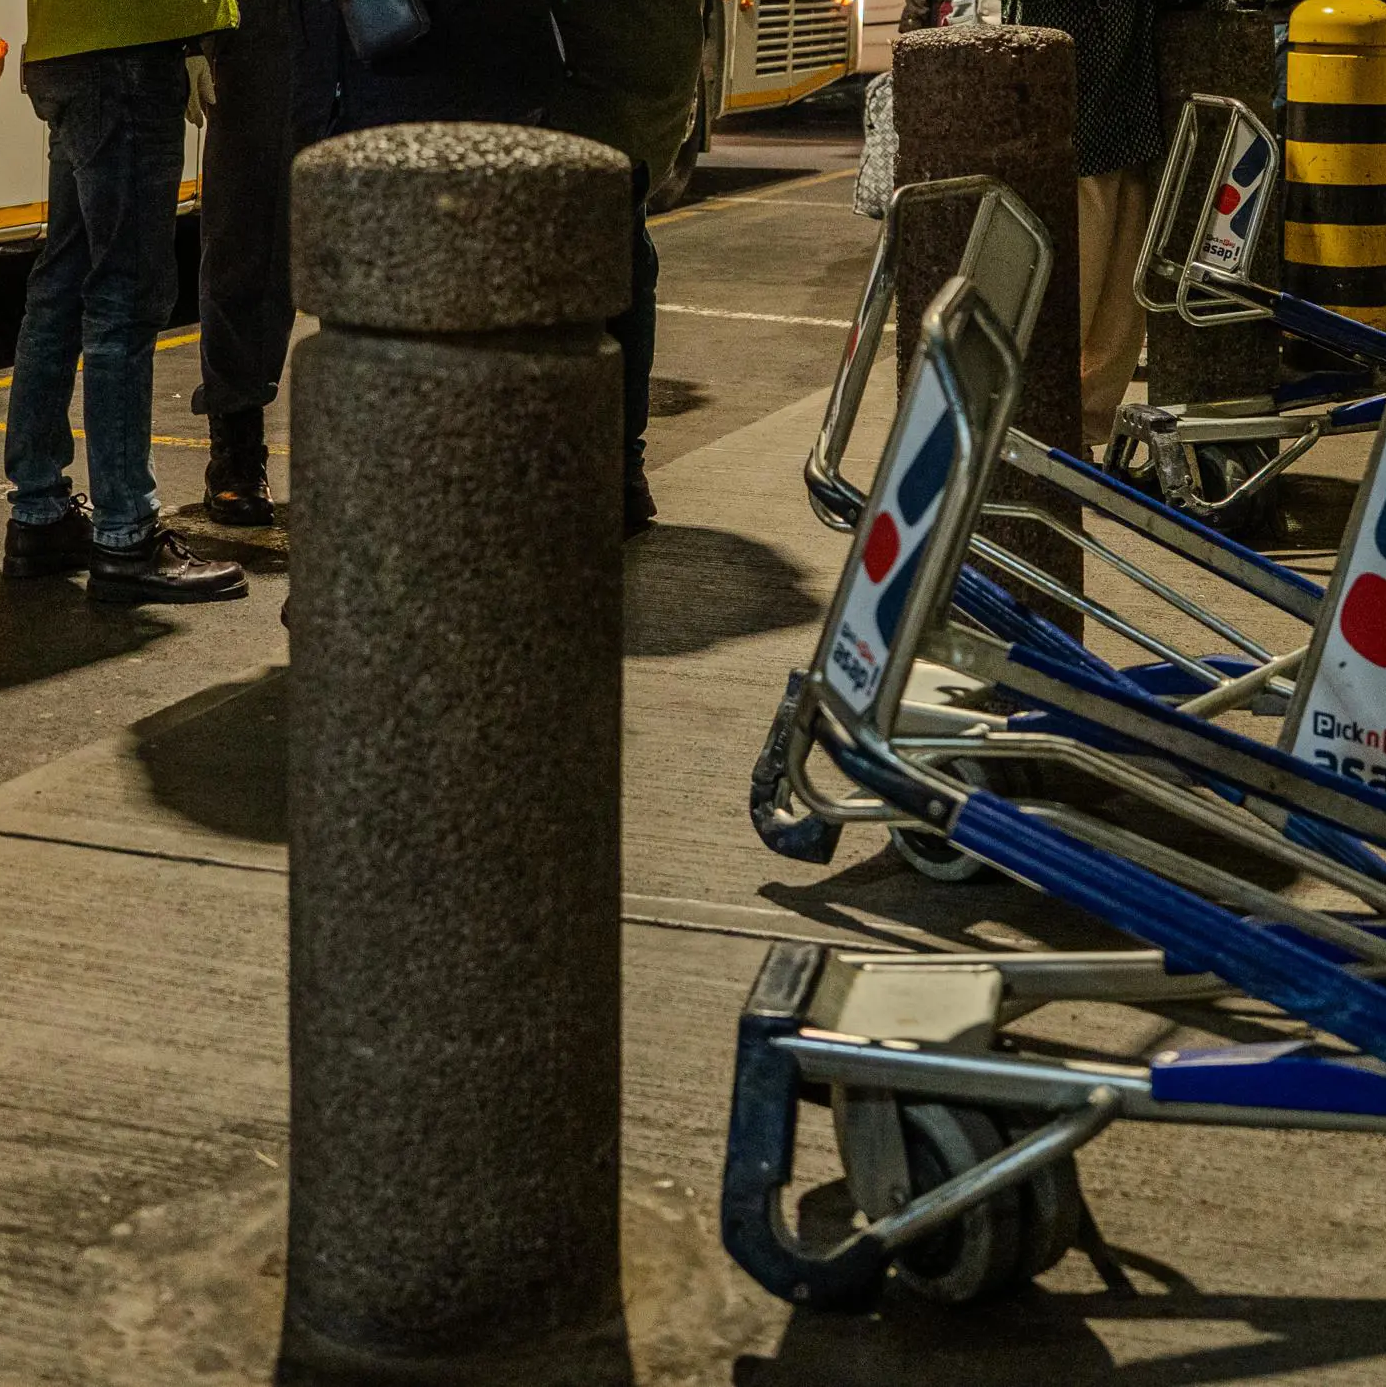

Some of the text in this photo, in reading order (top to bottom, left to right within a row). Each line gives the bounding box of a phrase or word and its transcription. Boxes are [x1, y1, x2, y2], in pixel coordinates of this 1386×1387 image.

[1203, 242, 1241, 262] asap!
[1313, 711, 1365, 745] Pick
[1366, 730, 1380, 749] n
